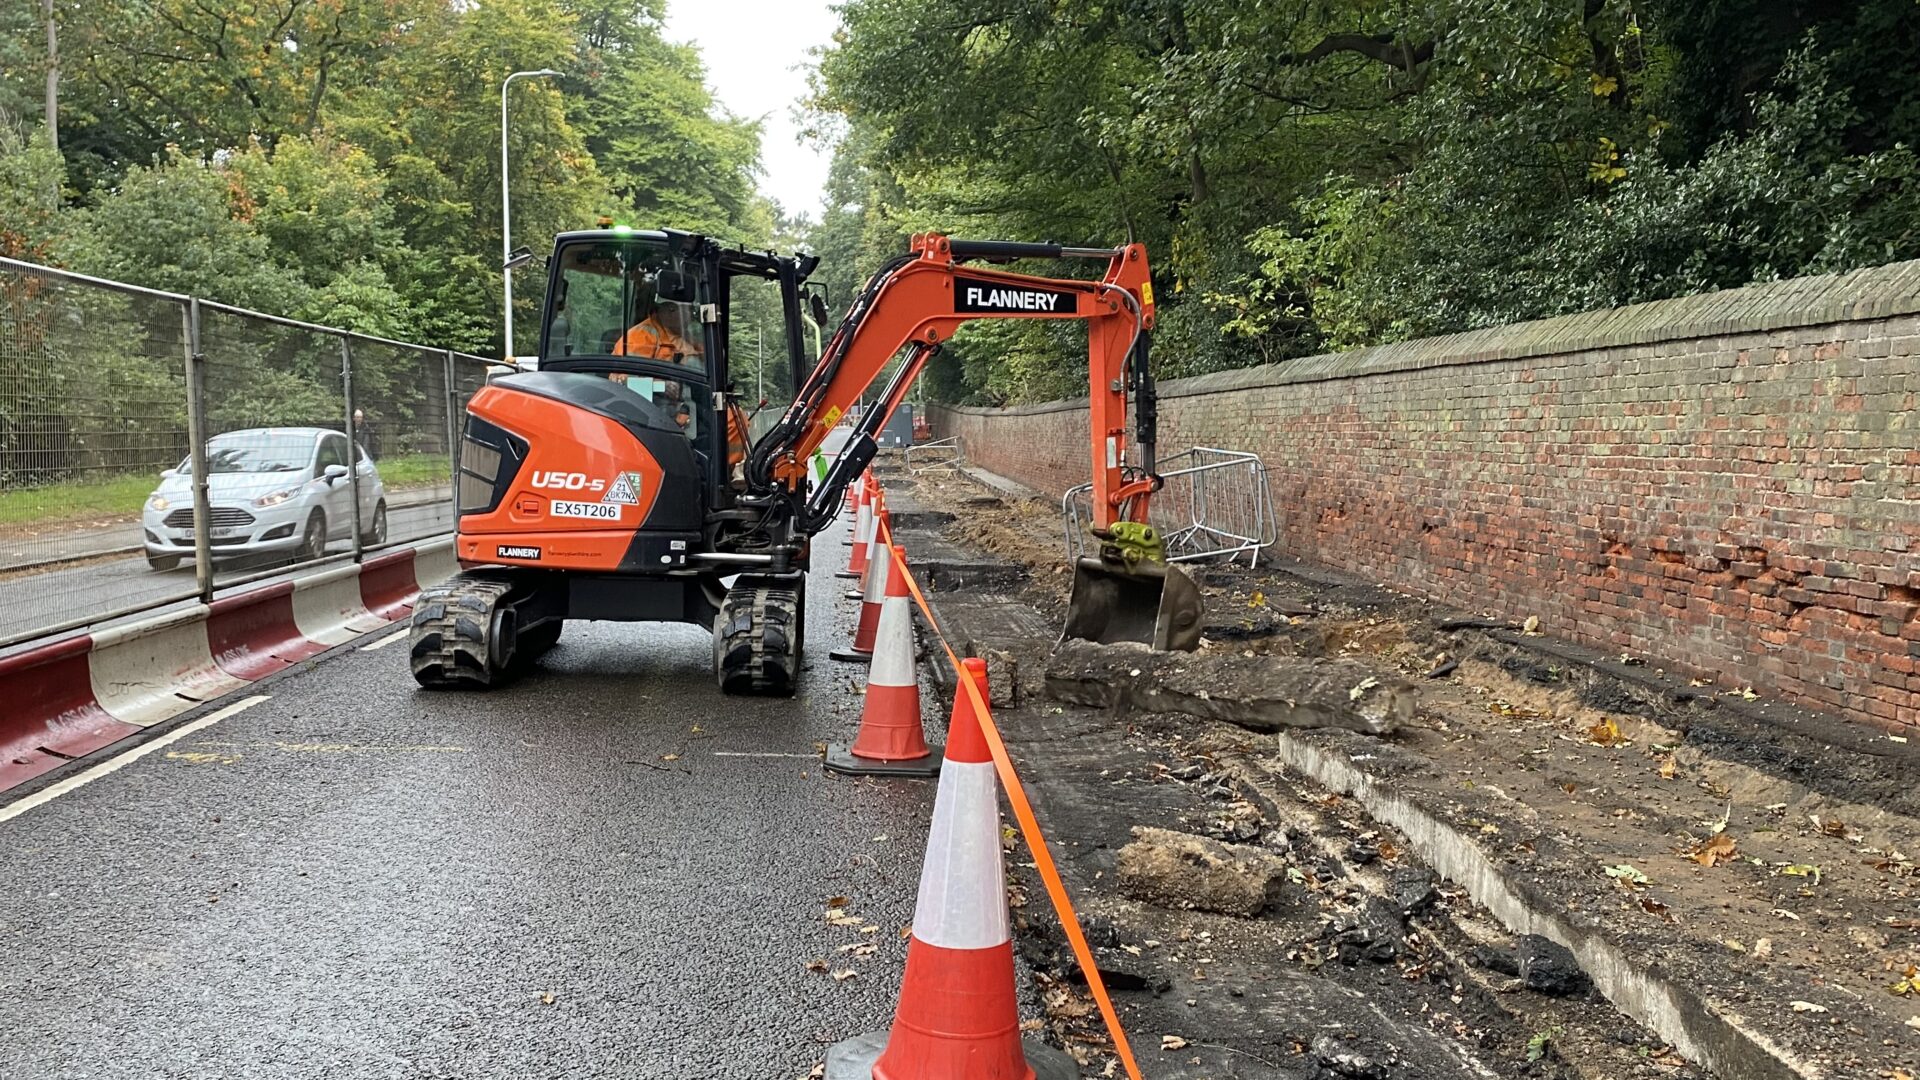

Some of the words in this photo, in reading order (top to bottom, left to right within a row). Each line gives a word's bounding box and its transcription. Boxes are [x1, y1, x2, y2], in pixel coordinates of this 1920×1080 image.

[967, 287, 1058, 311] FLANNERY
[617, 483, 626, 491] 21
[555, 502, 616, 518] EX5T206
[498, 547, 540, 558] FLANNERY
